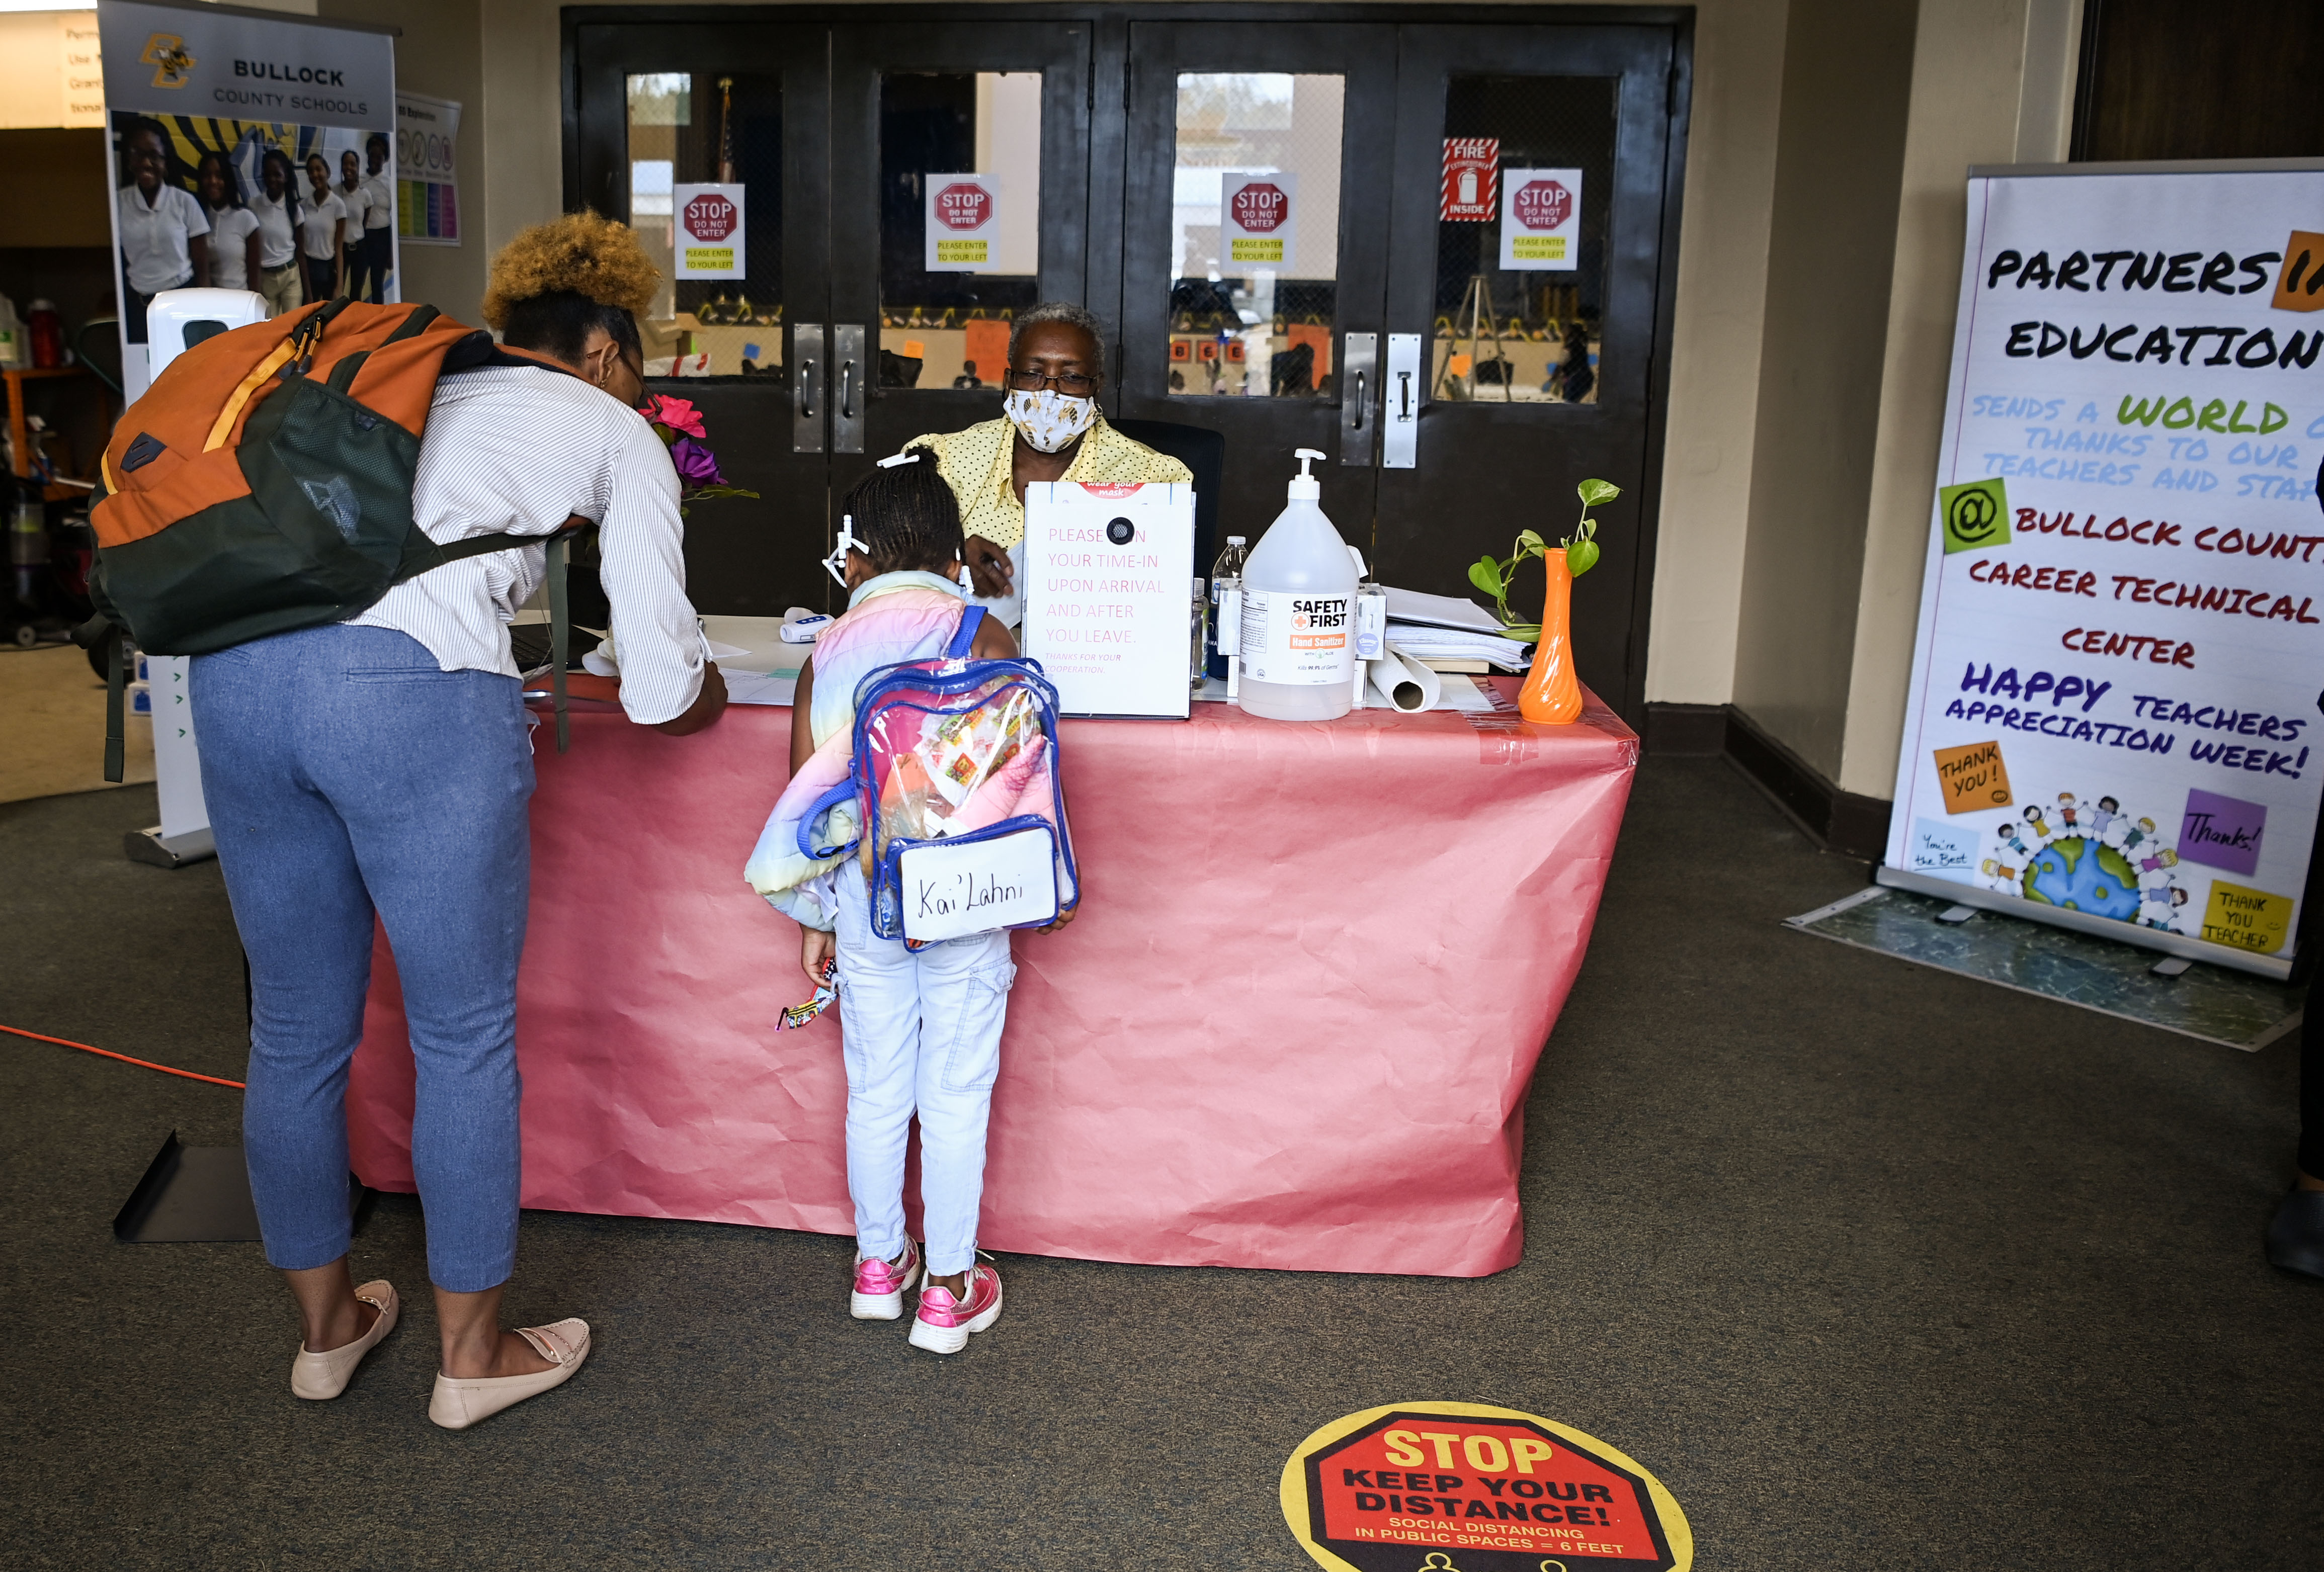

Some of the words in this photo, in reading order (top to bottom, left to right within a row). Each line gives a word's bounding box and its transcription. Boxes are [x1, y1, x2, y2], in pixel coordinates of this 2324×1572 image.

[234, 59, 344, 87] BULLOCK
[214, 88, 284, 107] COUNTY
[291, 95, 368, 115] SCHOOLS
[1454, 146, 1486, 158] FIRE
[942, 194, 984, 207] STOP
[1237, 192, 1283, 209] STOP
[1519, 189, 1567, 206] STOP
[689, 203, 732, 219] STOP
[1450, 205, 1485, 214] INSIDE
[1524, 208, 1538, 216] DO
[1541, 208, 1561, 216] NOT
[1526, 217, 1558, 225] ENTER
[1987, 249, 2283, 295] PARTNERS
[2005, 321, 2324, 370] EDUCATION
[1972, 395, 2065, 421] SENDS
[2077, 401, 2100, 423] A
[2117, 394, 2289, 435] WORLD
[2024, 426, 2153, 457] THANKS
[2167, 436, 2209, 462] TO
[2228, 441, 2298, 470] OUR
[1982, 453, 2141, 486] TEACHERS
[2152, 468, 2218, 492] AND
[2236, 473, 2316, 501] STAF
[1099, 488, 1124, 496] mask
[1949, 488, 1998, 543] @
[1049, 528, 1104, 542] PLEASE
[2016, 507, 2181, 547] BULLOCK
[2194, 526, 2324, 563] COUNT
[1048, 553, 1091, 567] YOUR
[1096, 555, 1158, 568] TIME-IN
[1048, 578, 1093, 592] UPON
[1099, 580, 1165, 593] ARRIVAL
[1969, 560, 2097, 597] CAREER
[2112, 575, 2320, 624] TECHNICAL
[1046, 604, 1081, 617] AND
[1086, 604, 1134, 618] AFTER
[1293, 599, 1348, 613] SAFETY
[1309, 613, 1347, 628] FIRST
[1046, 629, 1079, 642] YOU
[1085, 630, 1136, 643] LEAVE.
[1292, 637, 1312, 647] Hand
[1314, 637, 1344, 647] Sanitizer
[2062, 627, 2195, 669] CENTER
[1044, 665, 1106, 674] COOPERATION.
[1961, 662, 2112, 712] HAPPY
[2133, 694, 2307, 742] TEACHERS
[1945, 698, 2175, 754] APPRECIATION
[2190, 738, 2310, 779] WEEK!
[1940, 745, 1998, 778] THANK
[1923, 833, 1957, 851] You're
[2187, 813, 2262, 851] Thanks!
[1915, 854, 1935, 865] the
[1940, 853, 1967, 866] Best
[918, 872, 1022, 919] Kai'Lahni
[2219, 892, 2268, 912] THANK
[2226, 911, 2253, 927] YOU
[2203, 924, 2269, 948] TEACHER
[1383, 1429, 1553, 1474] STOP
[1343, 1468, 1463, 1494] KEEP
[1477, 1477, 1614, 1504] YOUR
[1355, 1491, 1611, 1527] DISTANCE!
[1389, 1517, 1461, 1532] SOCIAL
[1465, 1522, 1585, 1540] DISTANCING
[1355, 1527, 1375, 1538] IN
[1380, 1529, 1451, 1543] PUBLIC
[1456, 1534, 1534, 1549] SPACES
[1560, 1541, 1572, 1551] 6
[1576, 1542, 1624, 1555] FEET
